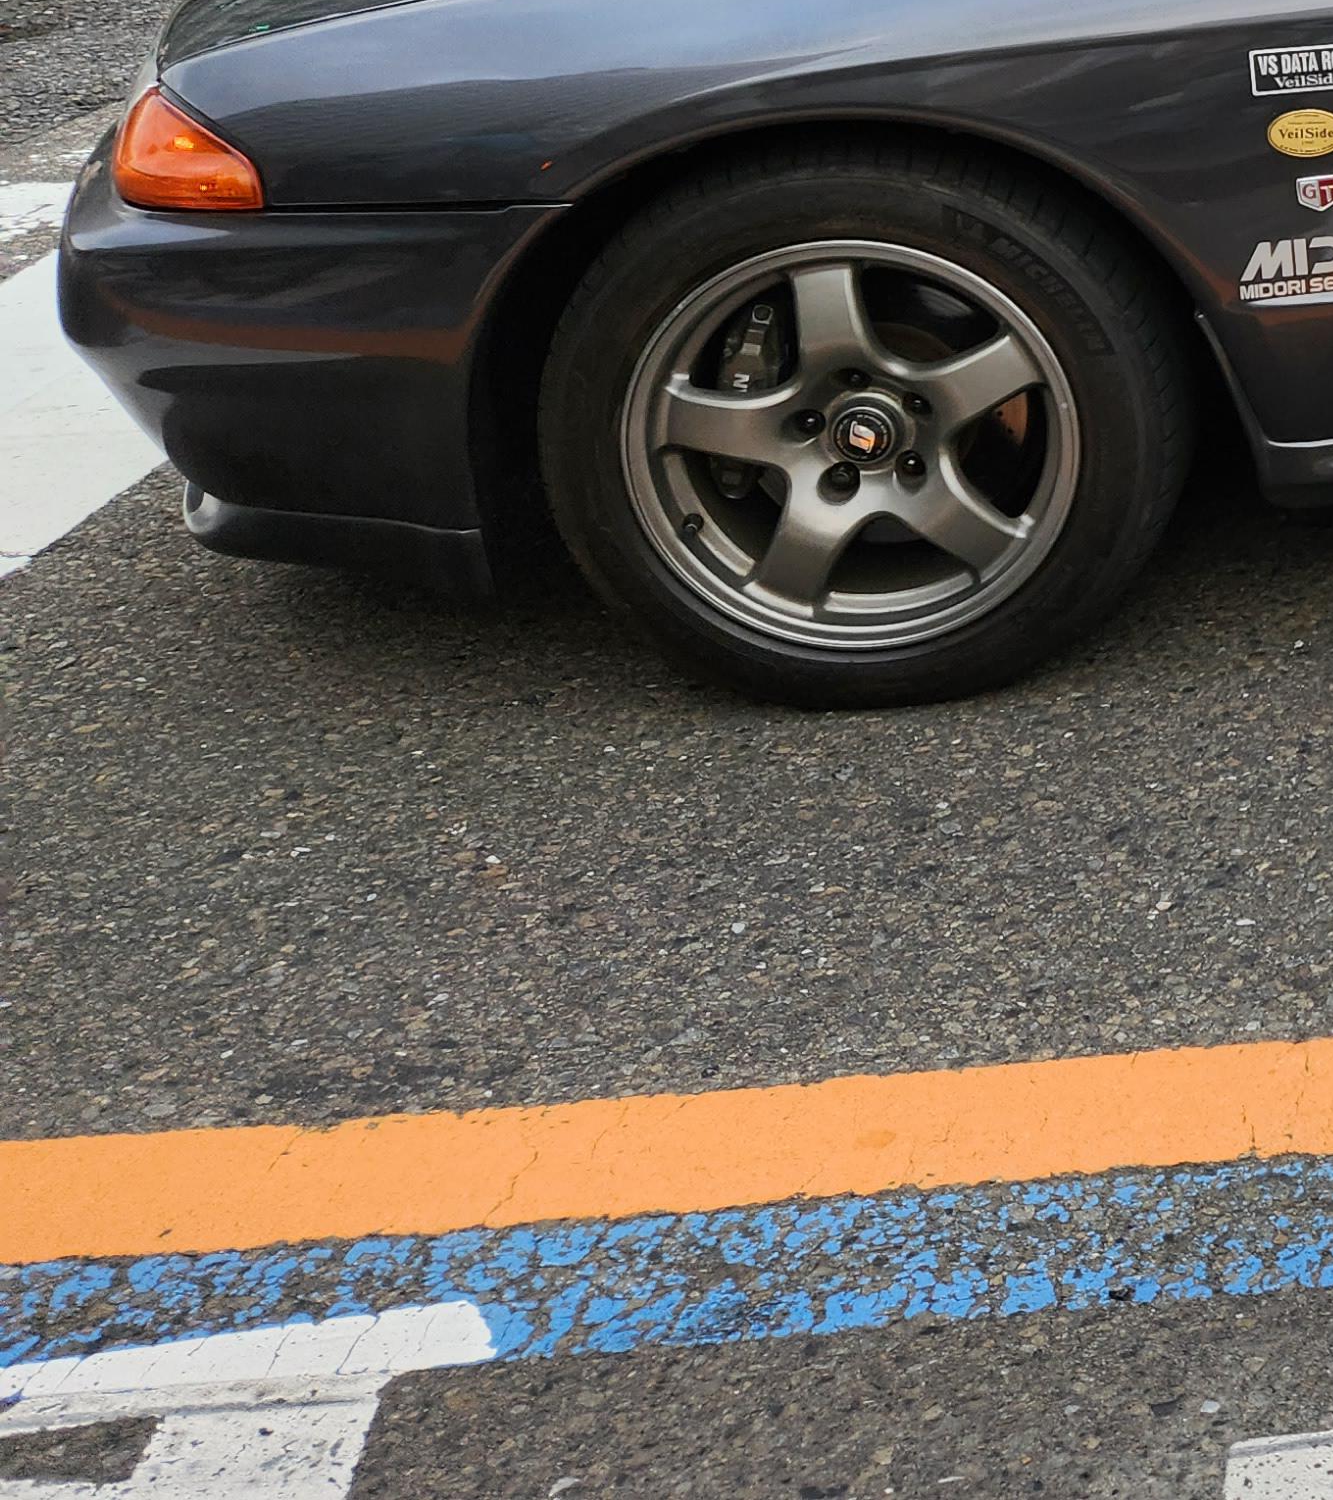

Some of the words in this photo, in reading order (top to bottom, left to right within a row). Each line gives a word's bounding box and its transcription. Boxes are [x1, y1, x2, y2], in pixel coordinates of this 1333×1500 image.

[1257, 55, 1279, 76] VS
[1281, 51, 1319, 75] DATA
[1240, 279, 1306, 300] MIDORI
